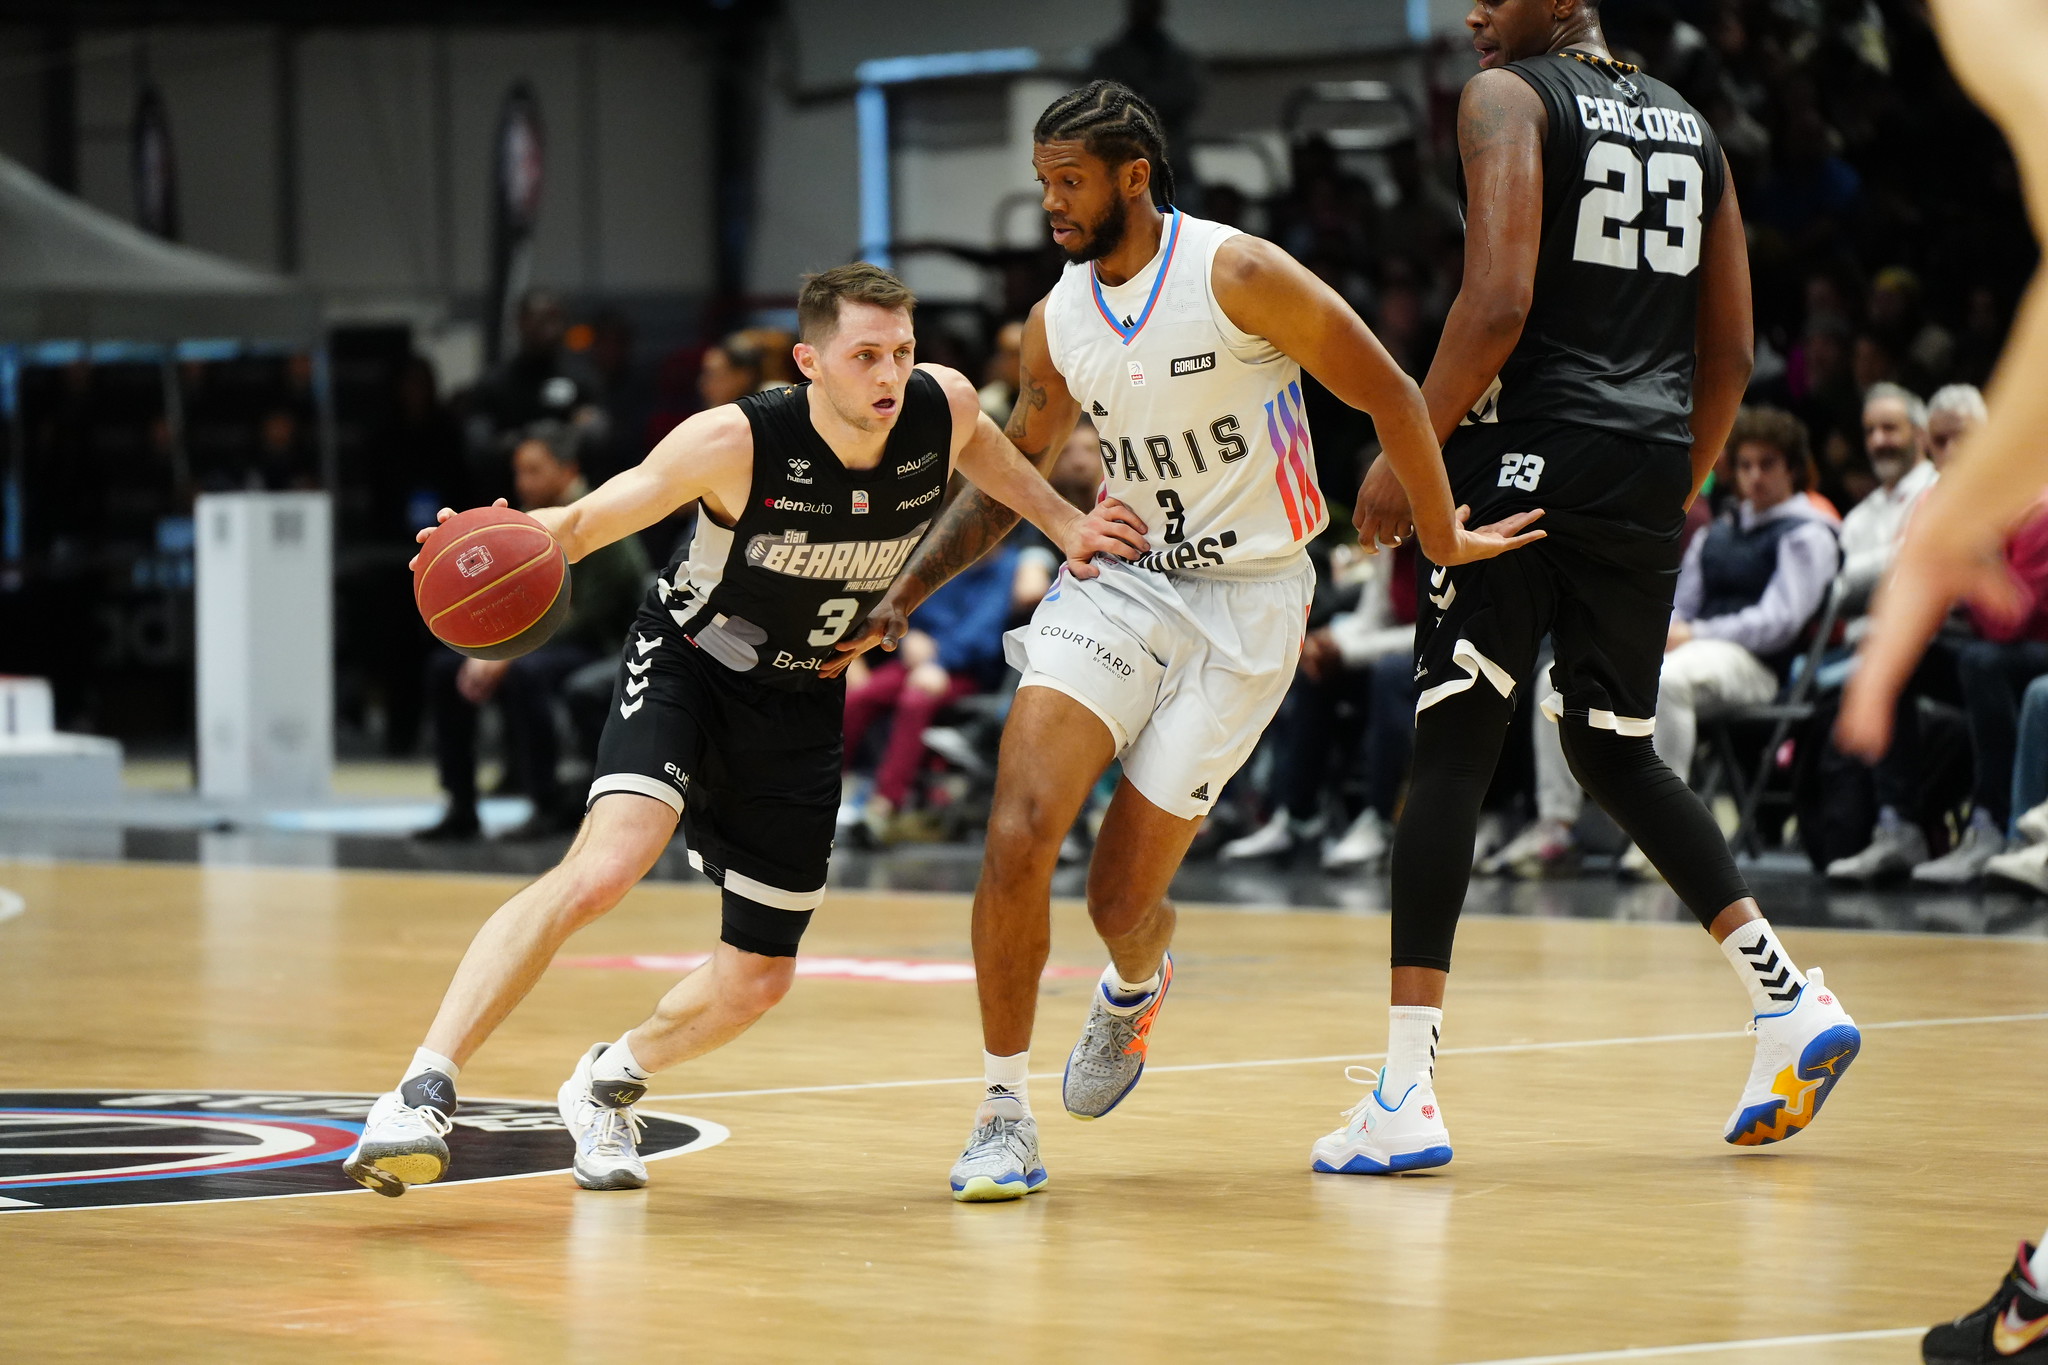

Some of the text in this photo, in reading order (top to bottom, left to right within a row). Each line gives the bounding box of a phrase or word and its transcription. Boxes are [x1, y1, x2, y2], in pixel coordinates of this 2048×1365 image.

[1577, 95, 1703, 147] CHIKOKO
[1573, 140, 1704, 277] 23
[1174, 355, 1212, 374] GORILLAS
[1100, 414, 1249, 483] PARIS
[786, 473, 813, 485] hummel
[896, 458, 921, 476] PAU
[1497, 452, 1546, 493] 23
[764, 495, 833, 515] edenauto
[1155, 488, 1186, 545] 3
[783, 530, 807, 544] Elan
[806, 597, 860, 648] 3
[1092, 656, 1127, 683] BY MARRIOTT
